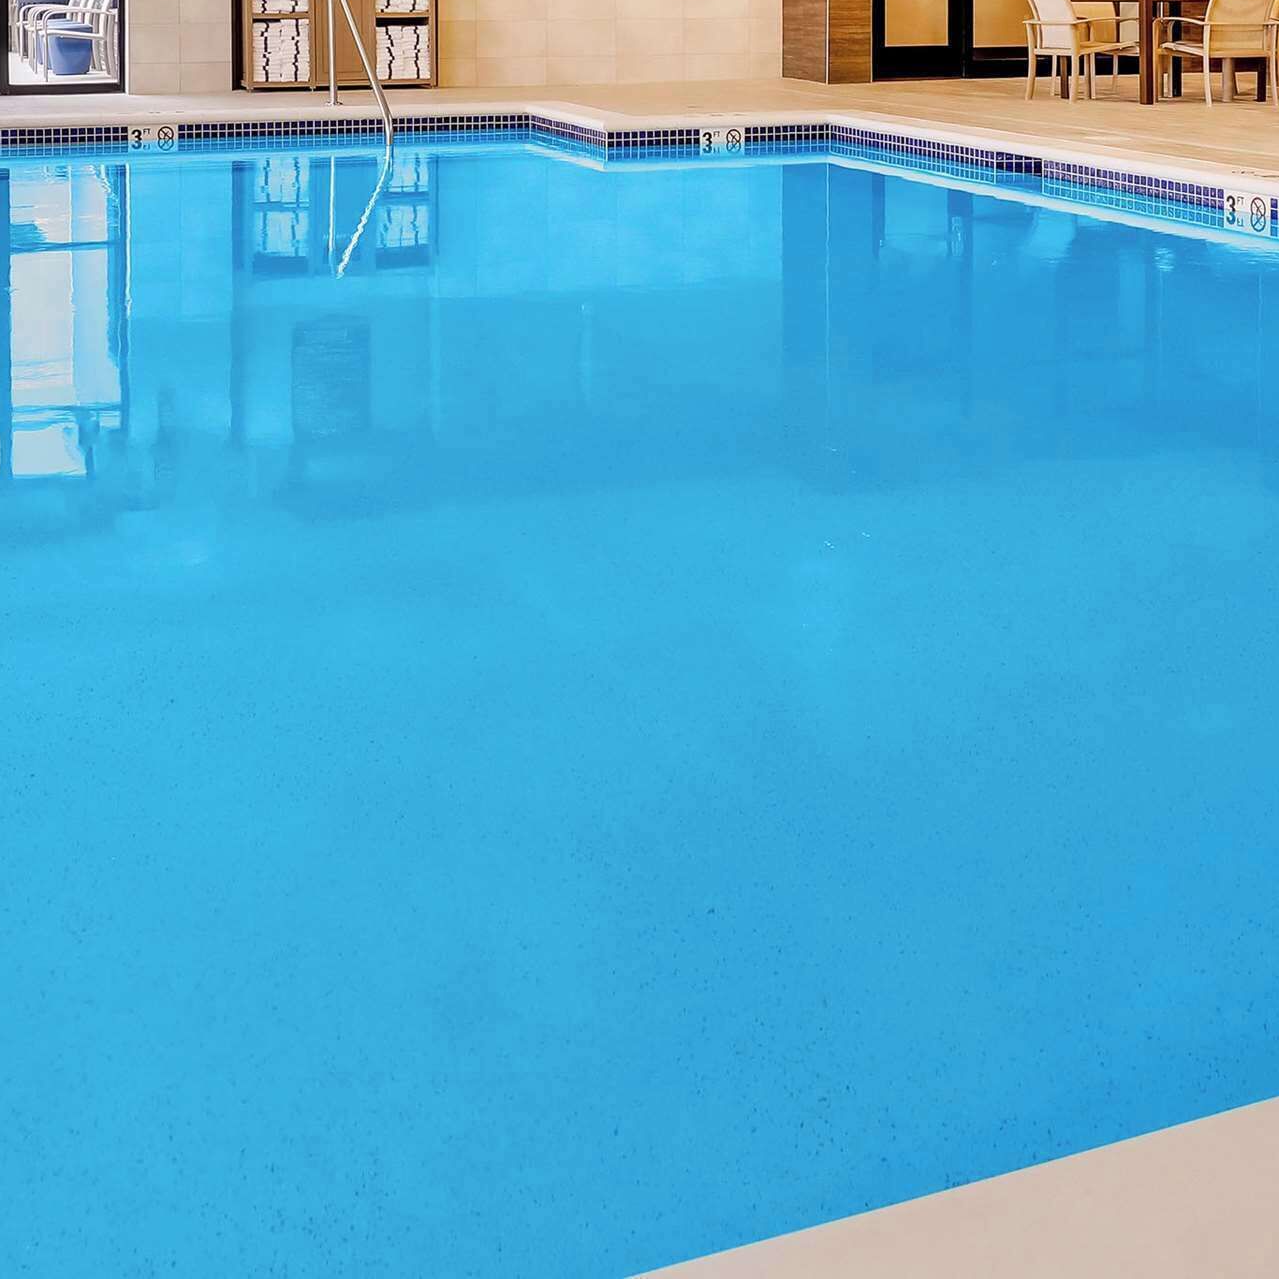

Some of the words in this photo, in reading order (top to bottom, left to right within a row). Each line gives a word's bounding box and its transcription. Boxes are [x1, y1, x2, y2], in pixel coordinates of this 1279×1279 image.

[131, 129, 142, 141] 3
[702, 132, 712, 145] 3
[1226, 195, 1236, 212] 3
[1237, 196, 1244, 205] FT
